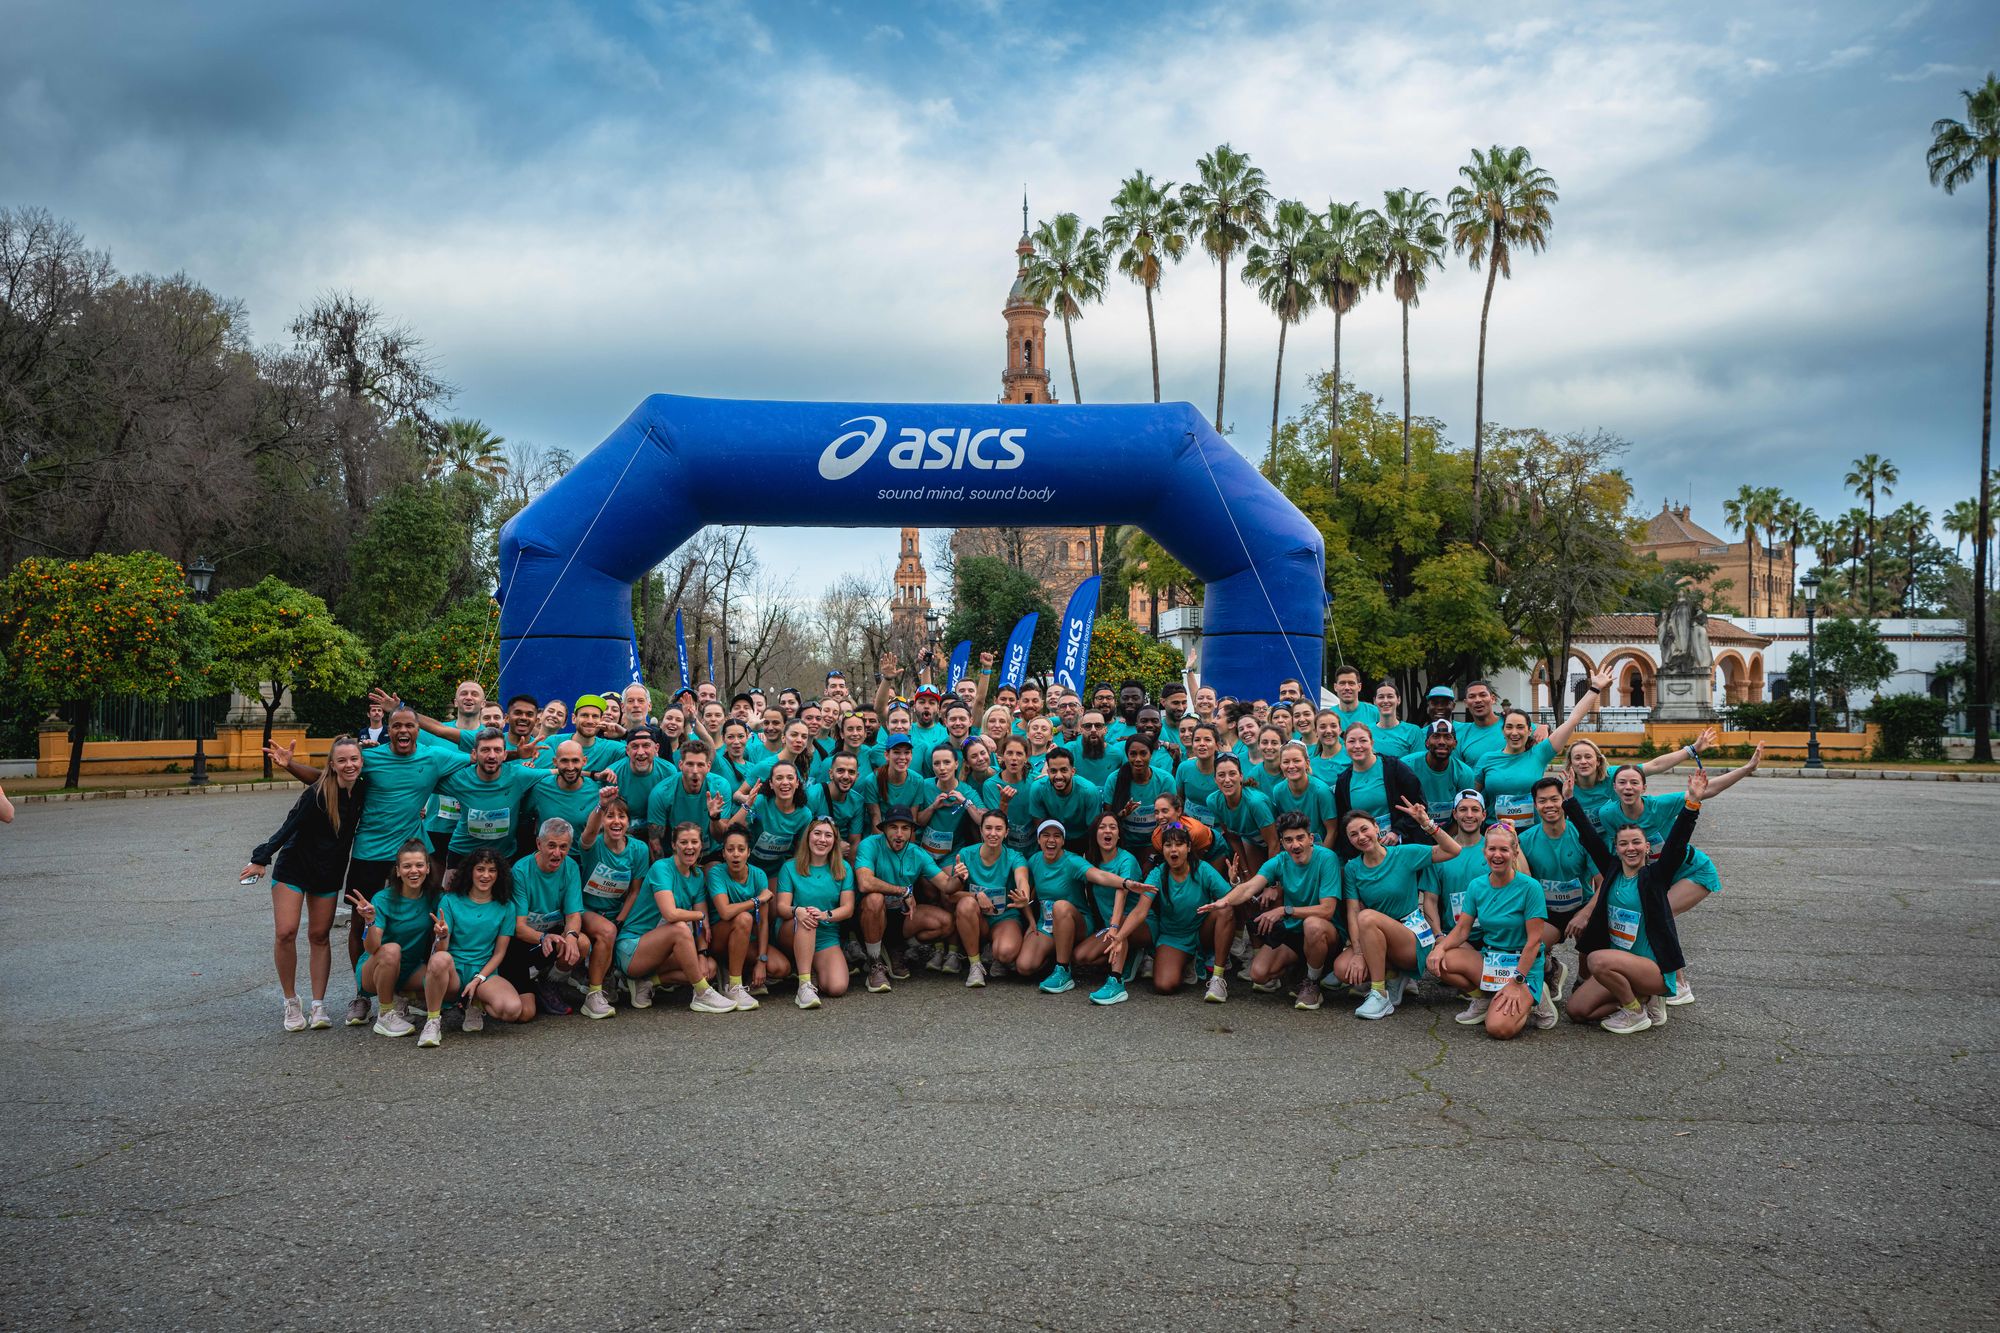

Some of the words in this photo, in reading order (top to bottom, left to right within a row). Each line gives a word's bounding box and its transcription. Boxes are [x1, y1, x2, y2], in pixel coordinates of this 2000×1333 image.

[877, 486, 925, 500] sound
[926, 486, 965, 501] mind,
[968, 486, 1016, 500] sound
[1017, 486, 1056, 502] body
[470, 809, 489, 820] 5K
[595, 864, 613, 879] 5K
